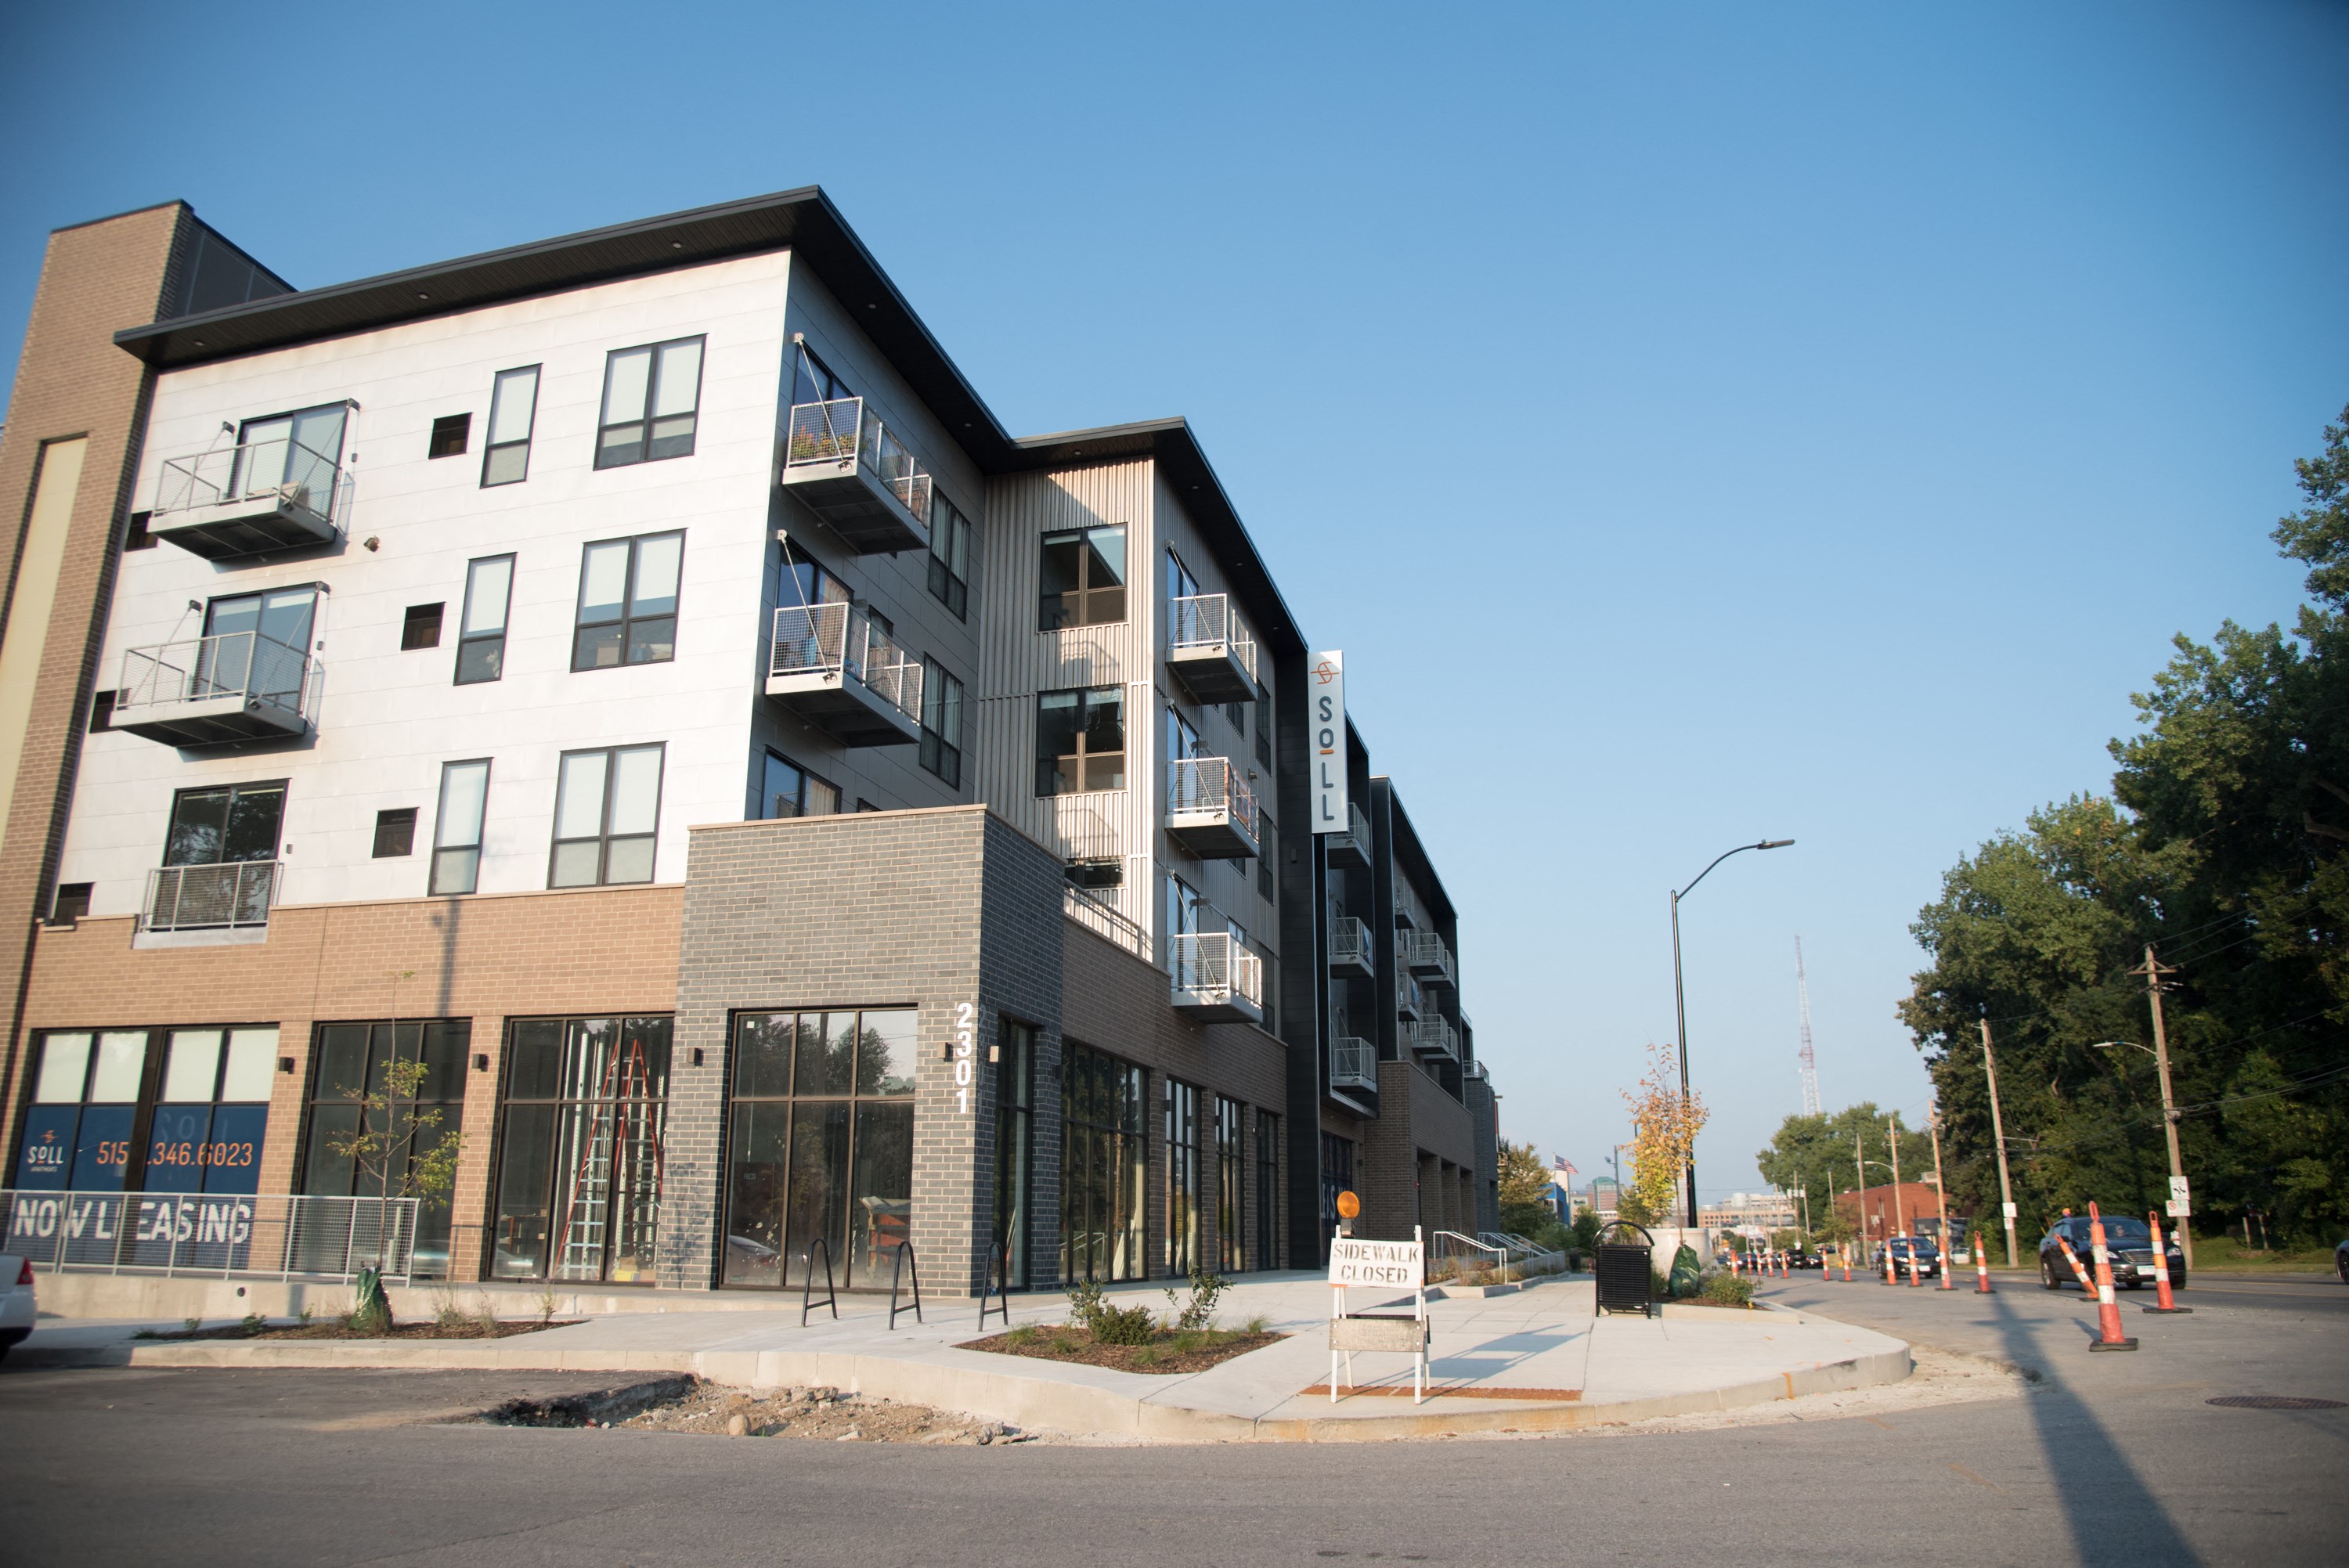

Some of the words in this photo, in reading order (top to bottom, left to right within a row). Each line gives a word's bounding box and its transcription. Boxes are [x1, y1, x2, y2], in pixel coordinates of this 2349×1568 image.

[1319, 694, 1334, 820] SOLL
[955, 1002, 972, 1114] 2301
[27, 1146, 64, 1164] SOLL
[14, 1199, 93, 1238] NOW
[95, 1201, 251, 1243] LEASING
[1333, 1243, 1419, 1263] SIDEWALK
[1341, 1265, 1408, 1283] CLOSED
